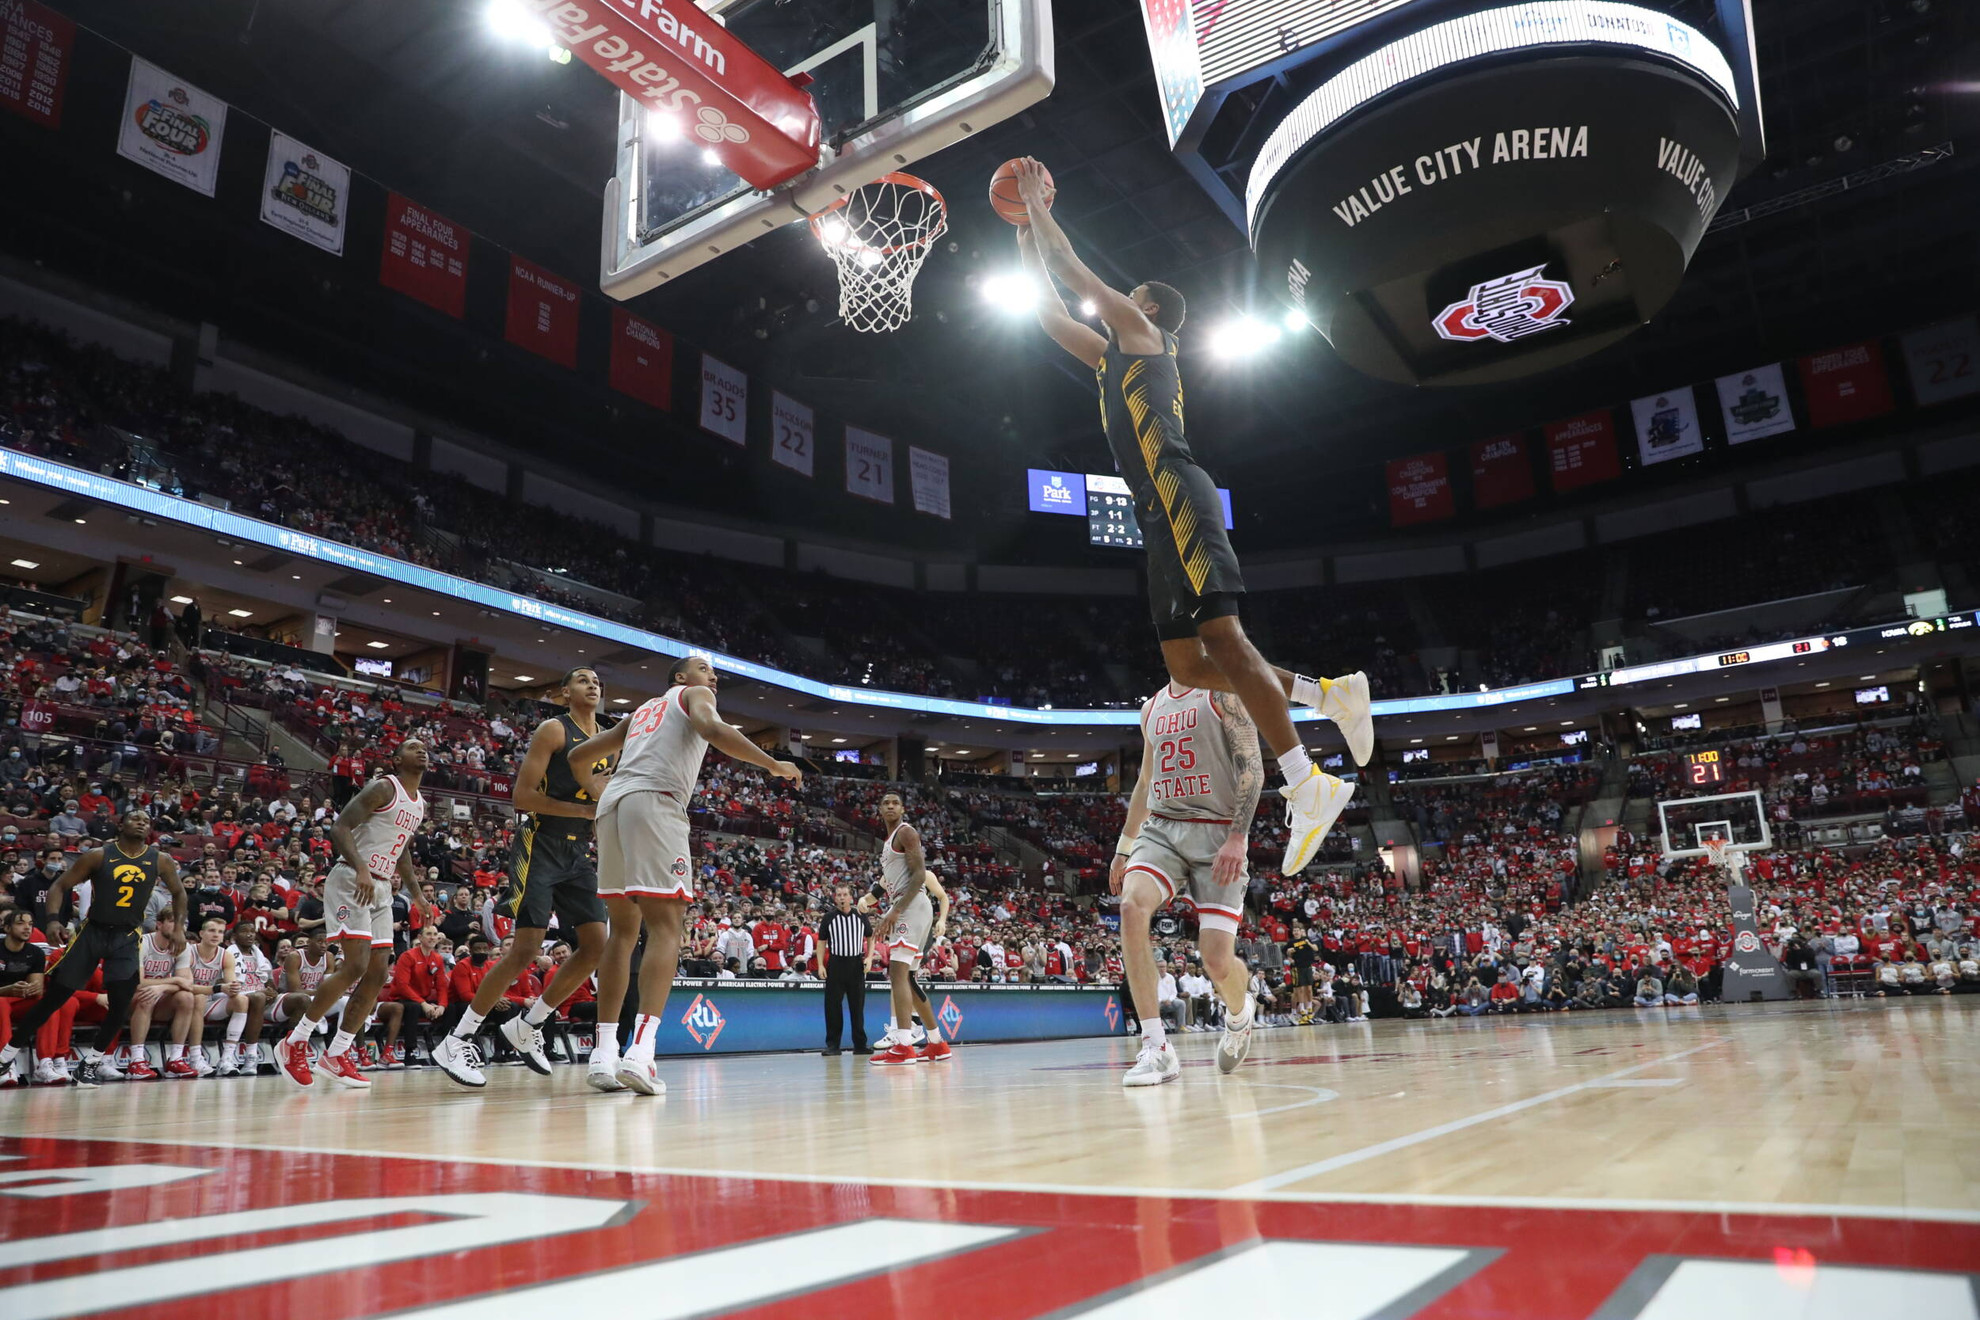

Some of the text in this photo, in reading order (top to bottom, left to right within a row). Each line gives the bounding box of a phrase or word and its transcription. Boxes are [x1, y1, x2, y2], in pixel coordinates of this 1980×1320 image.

[141, 111, 198, 150] FOUR
[161, 108, 200, 136] FINAL
[1332, 125, 1589, 228] VALUE CITY ARENA
[1657, 137, 1706, 195] VALUE
[400, 214, 459, 251] APPEARANCES
[407, 206, 454, 237] FINAL FOUR
[515, 265, 576, 303] NCAA RUNNER-UP
[626, 326, 661, 351] CHAMPIONS
[628, 318, 658, 341] NATIONAL
[703, 370, 746, 399] BRADDS
[712, 391, 736, 422] 35
[780, 426, 806, 457] 22
[849, 442, 889, 463] TURNER
[858, 459, 883, 485] 21
[1042, 485, 1072, 500] Park
[1103, 535, 1110, 543] 5
[1126, 537, 1133, 545] 2
[521, 598, 543, 614] Park
[1881, 628, 1907, 639] IOWA
[1722, 653, 1748, 664] 11:00
[1795, 643, 1810, 652] 21
[28, 710, 53, 725] 105
[627, 699, 669, 740] 23
[1155, 708, 1198, 736] OHIO
[1160, 736, 1197, 773] 25
[1690, 750, 1719, 764] 11:00
[1692, 763, 1720, 784] 21
[493, 782, 509, 792] 106
[1153, 774, 1212, 801] STATE
[395, 809, 420, 832] OHIO
[389, 833, 406, 857] 2
[116, 886, 135, 908] 2
[144, 960, 170, 972] OHIO
[193, 968, 220, 980] OHIO
[300, 971, 324, 984] OHIO
